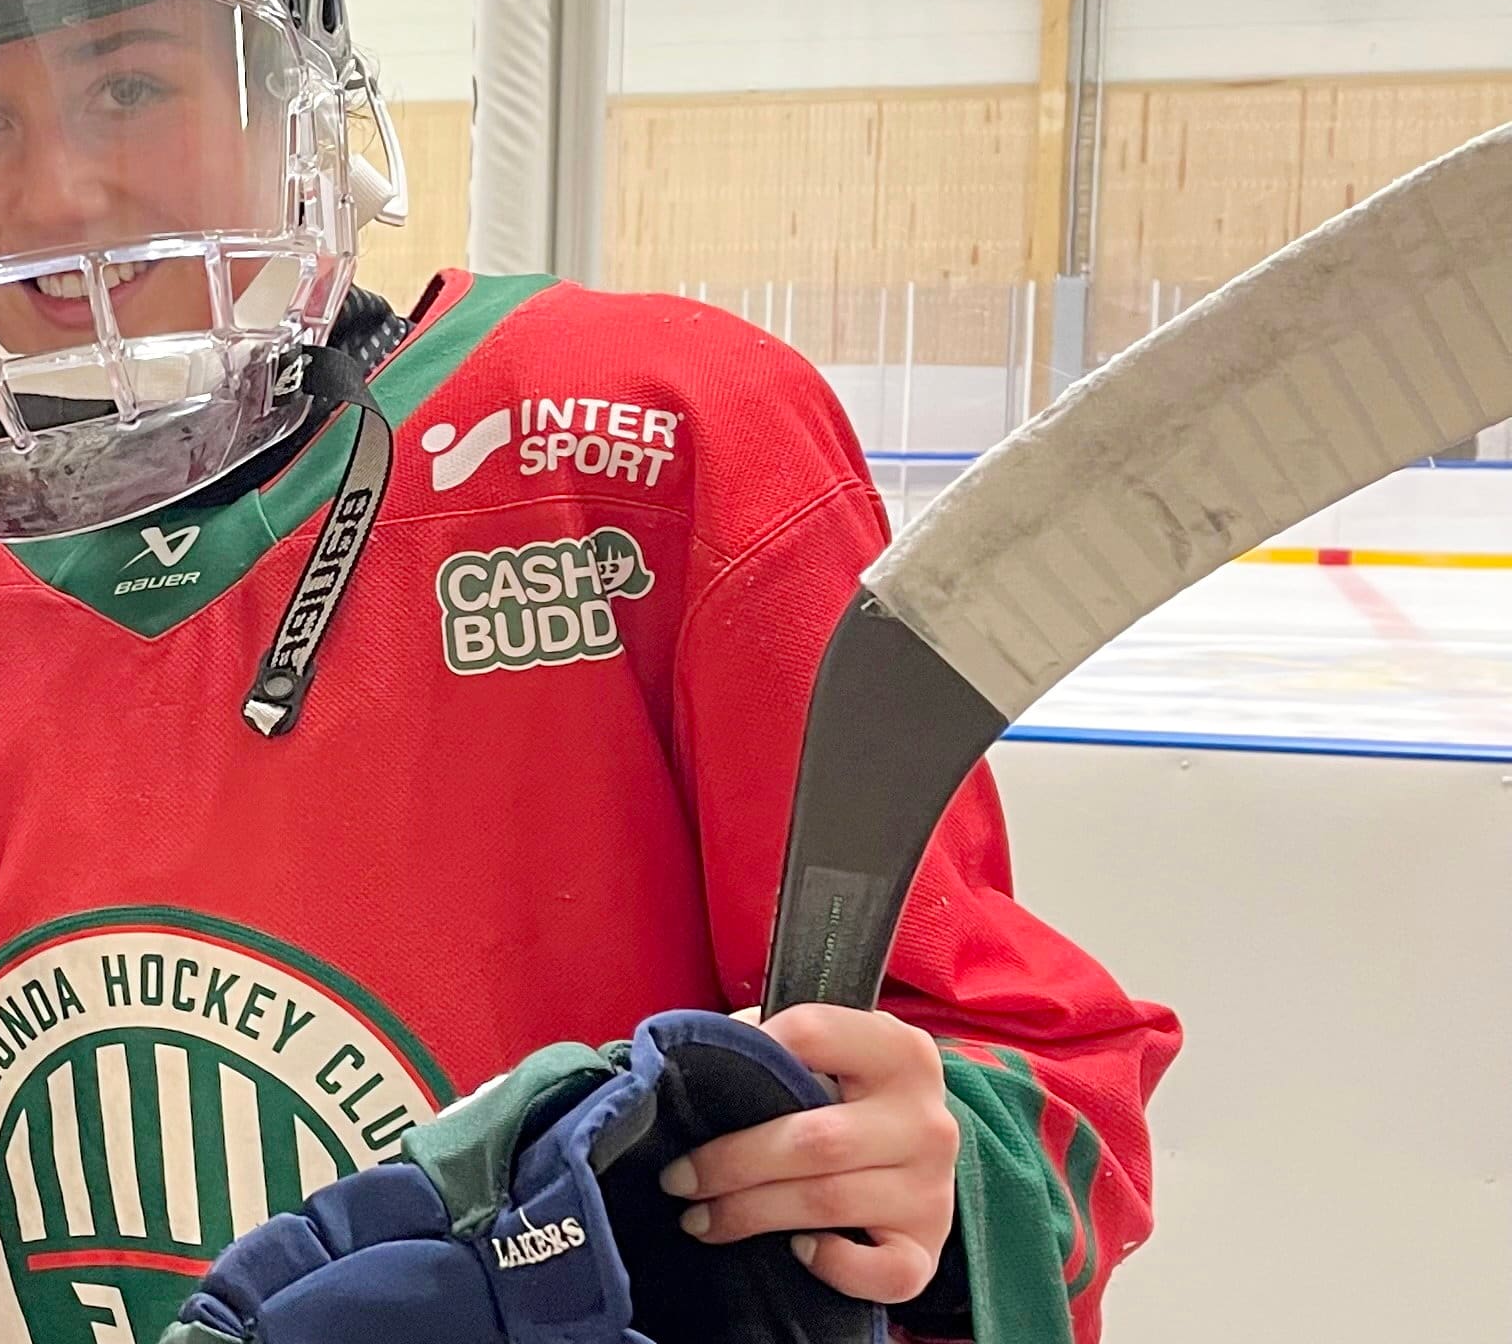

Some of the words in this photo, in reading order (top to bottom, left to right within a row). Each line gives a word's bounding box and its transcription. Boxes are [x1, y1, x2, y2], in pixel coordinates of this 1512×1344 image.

[520, 397, 680, 448] INTER
[519, 436, 674, 487] SPORT
[448, 549, 603, 612] CASH
[453, 599, 618, 662] BUDD
[101, 953, 316, 1054] HOCKEY
[315, 1043, 418, 1164] CLU
[491, 1217, 586, 1269] LAKERS
